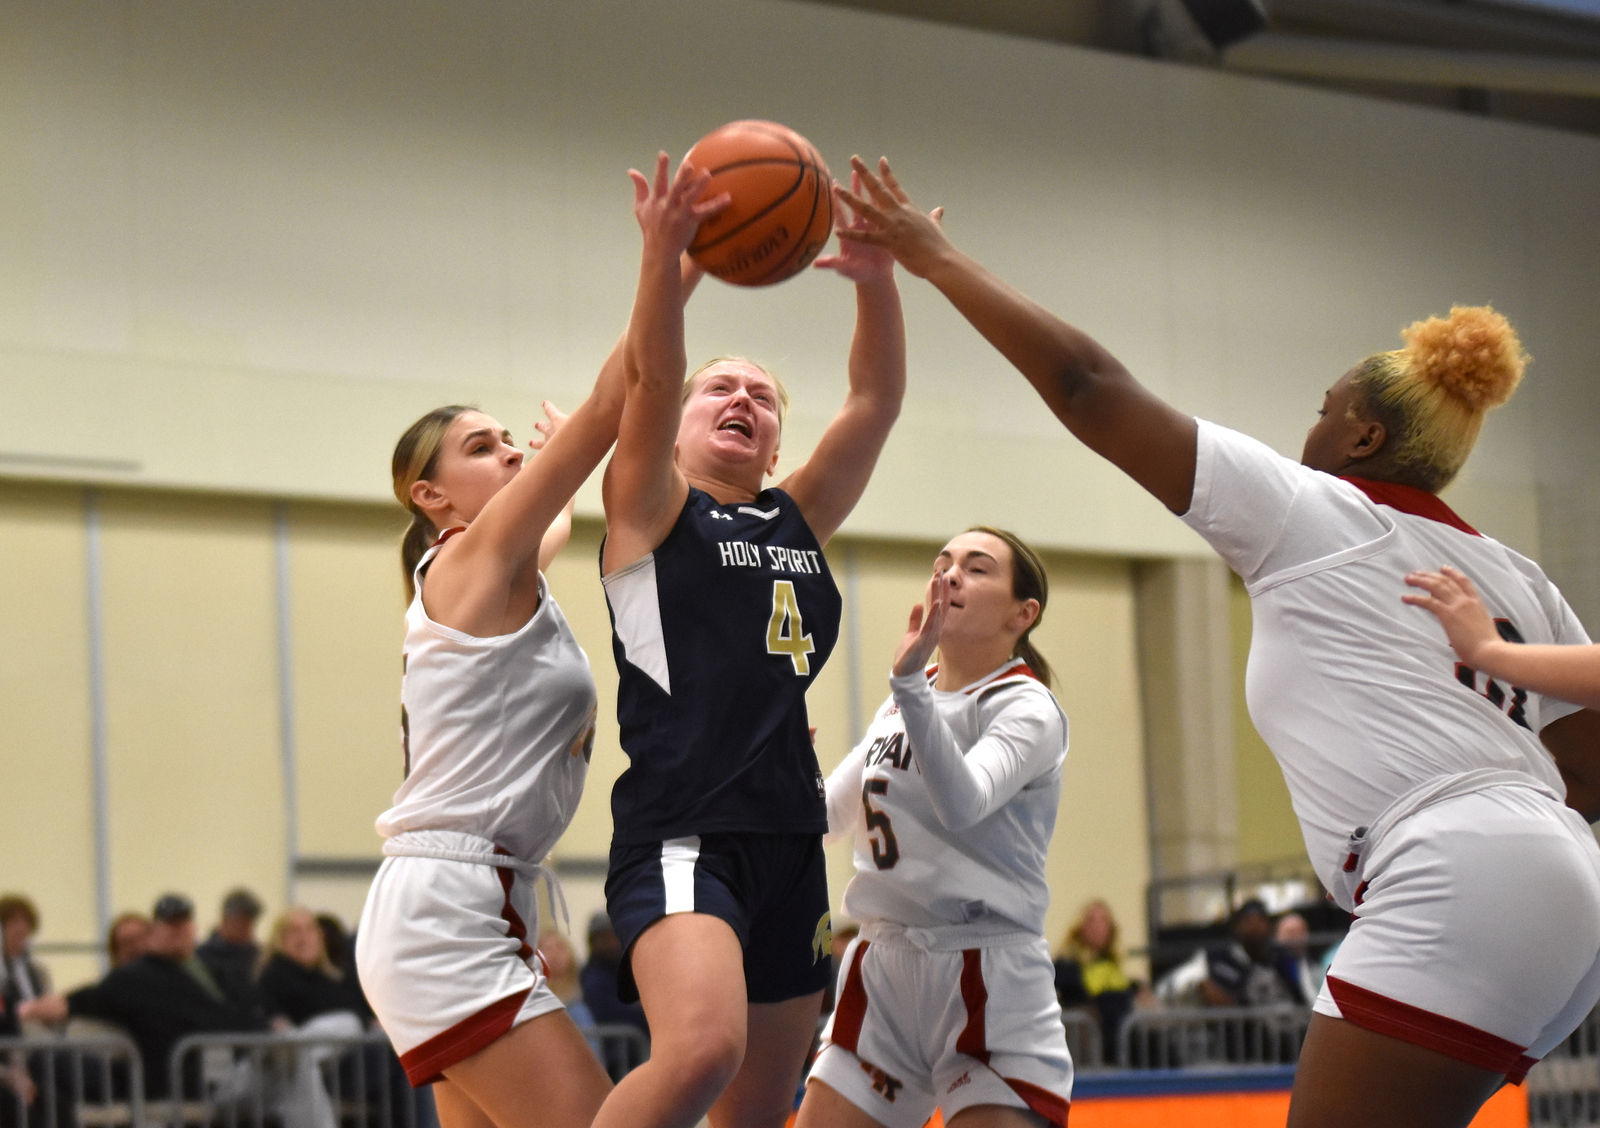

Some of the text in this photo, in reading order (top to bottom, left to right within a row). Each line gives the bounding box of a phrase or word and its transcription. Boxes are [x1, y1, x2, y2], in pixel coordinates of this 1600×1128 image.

[718, 541, 821, 574] HOLY SPIRIT
[766, 580, 816, 676] 4
[862, 777, 900, 871] 5
